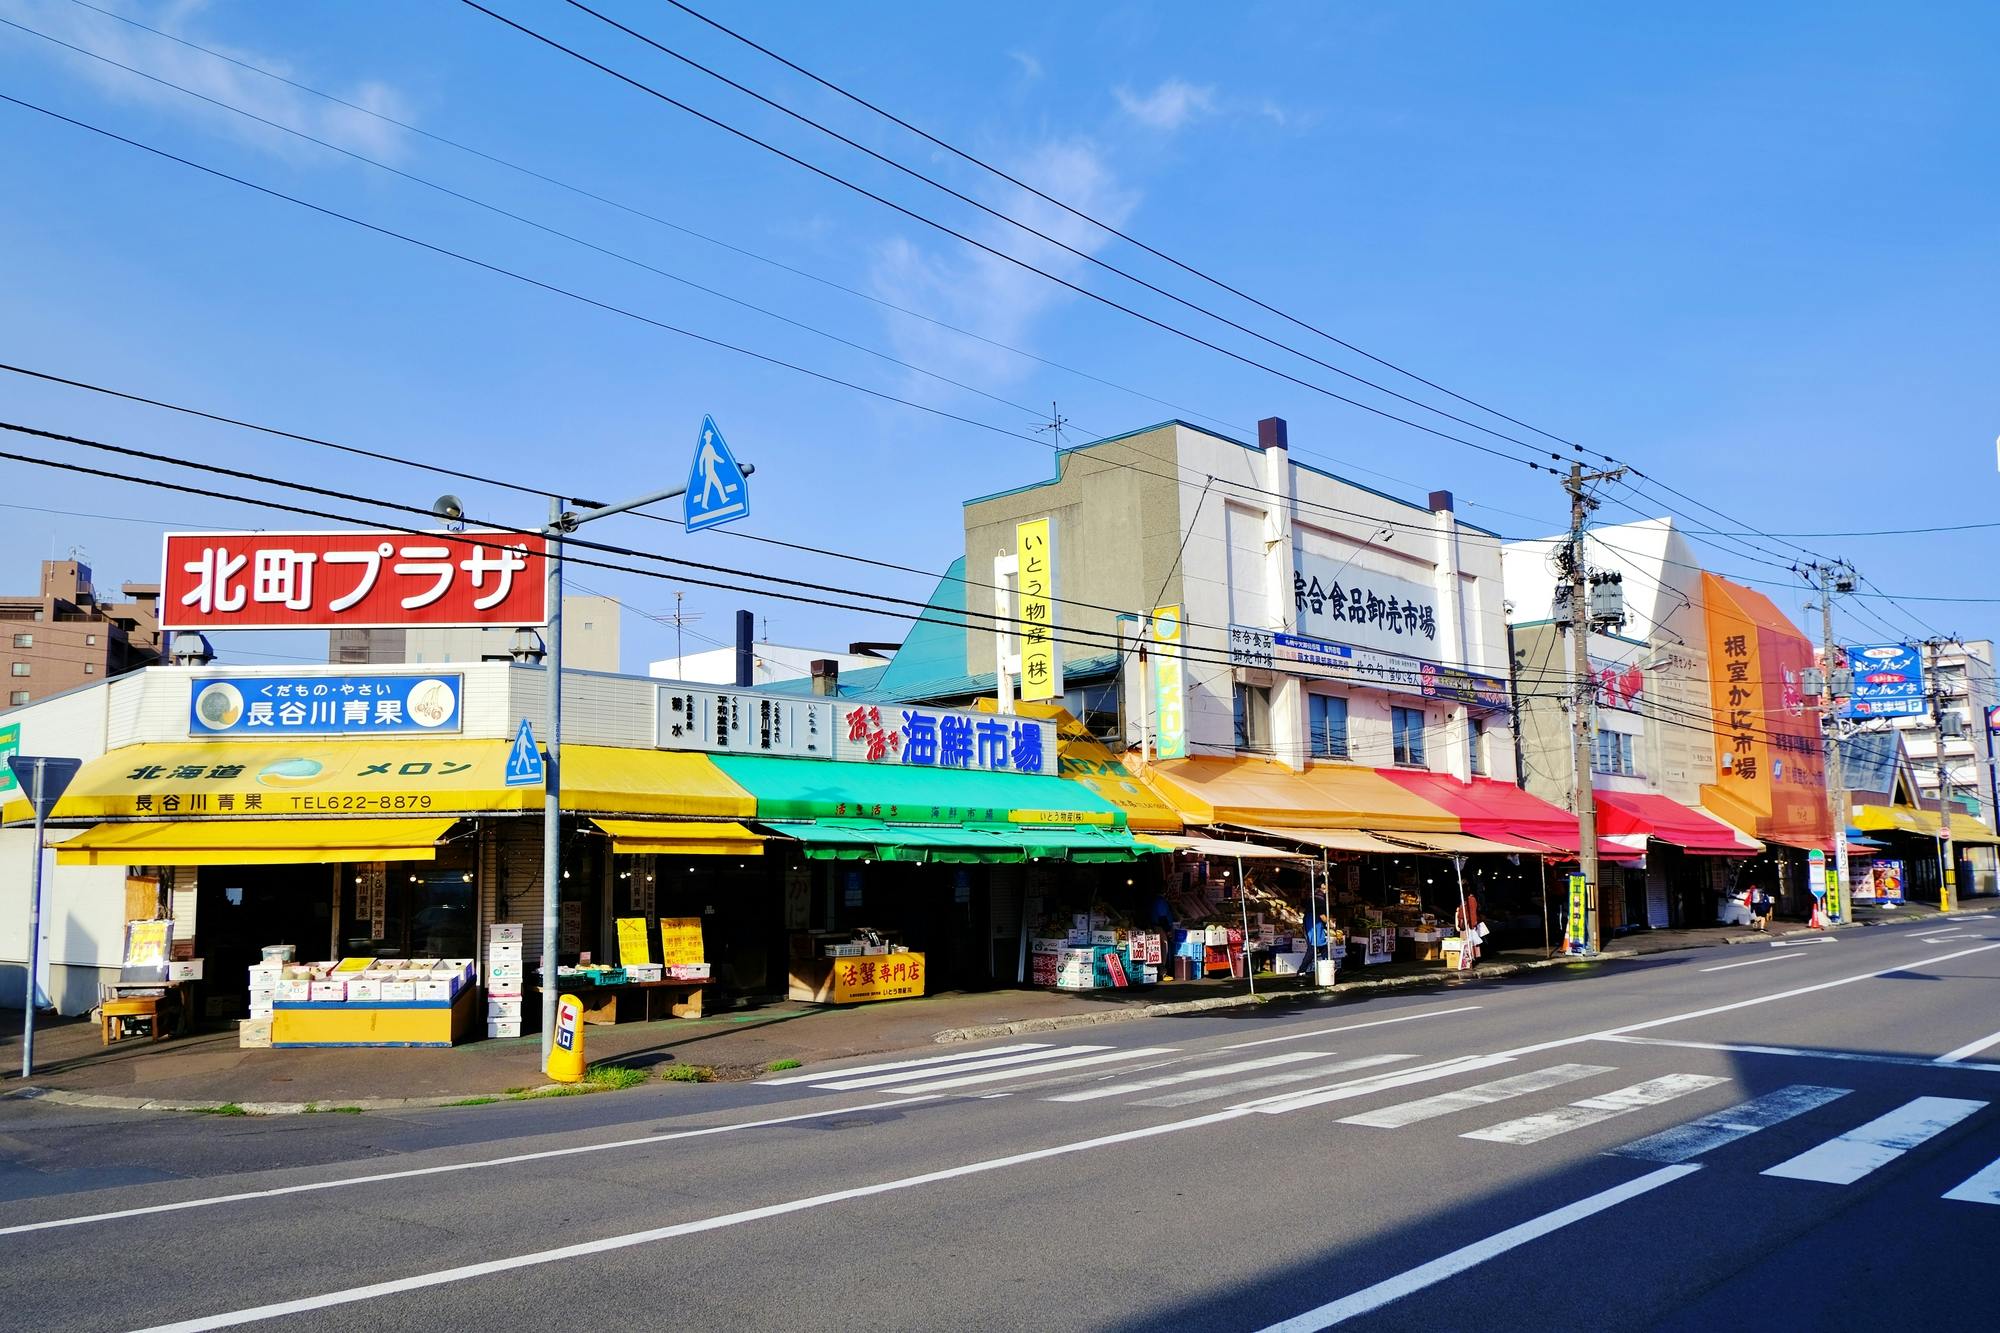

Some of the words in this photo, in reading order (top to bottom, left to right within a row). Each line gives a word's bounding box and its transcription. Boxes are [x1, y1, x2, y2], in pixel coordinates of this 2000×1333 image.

[182, 541, 530, 614] 北町プラザ
[260, 683, 391, 697] くだもの・やさい
[247, 699, 403, 727] 長谷川青果
[1725, 635, 1757, 780] 根室かに市場
[901, 710, 1043, 772] 海鮮市場
[126, 763, 248, 781] 北海道
[357, 760, 473, 778] メロン
[135, 793, 262, 812] 長谷川青果
[290, 794, 432, 811] TEL622-8879
[842, 961, 920, 987] 活蟹専門店
